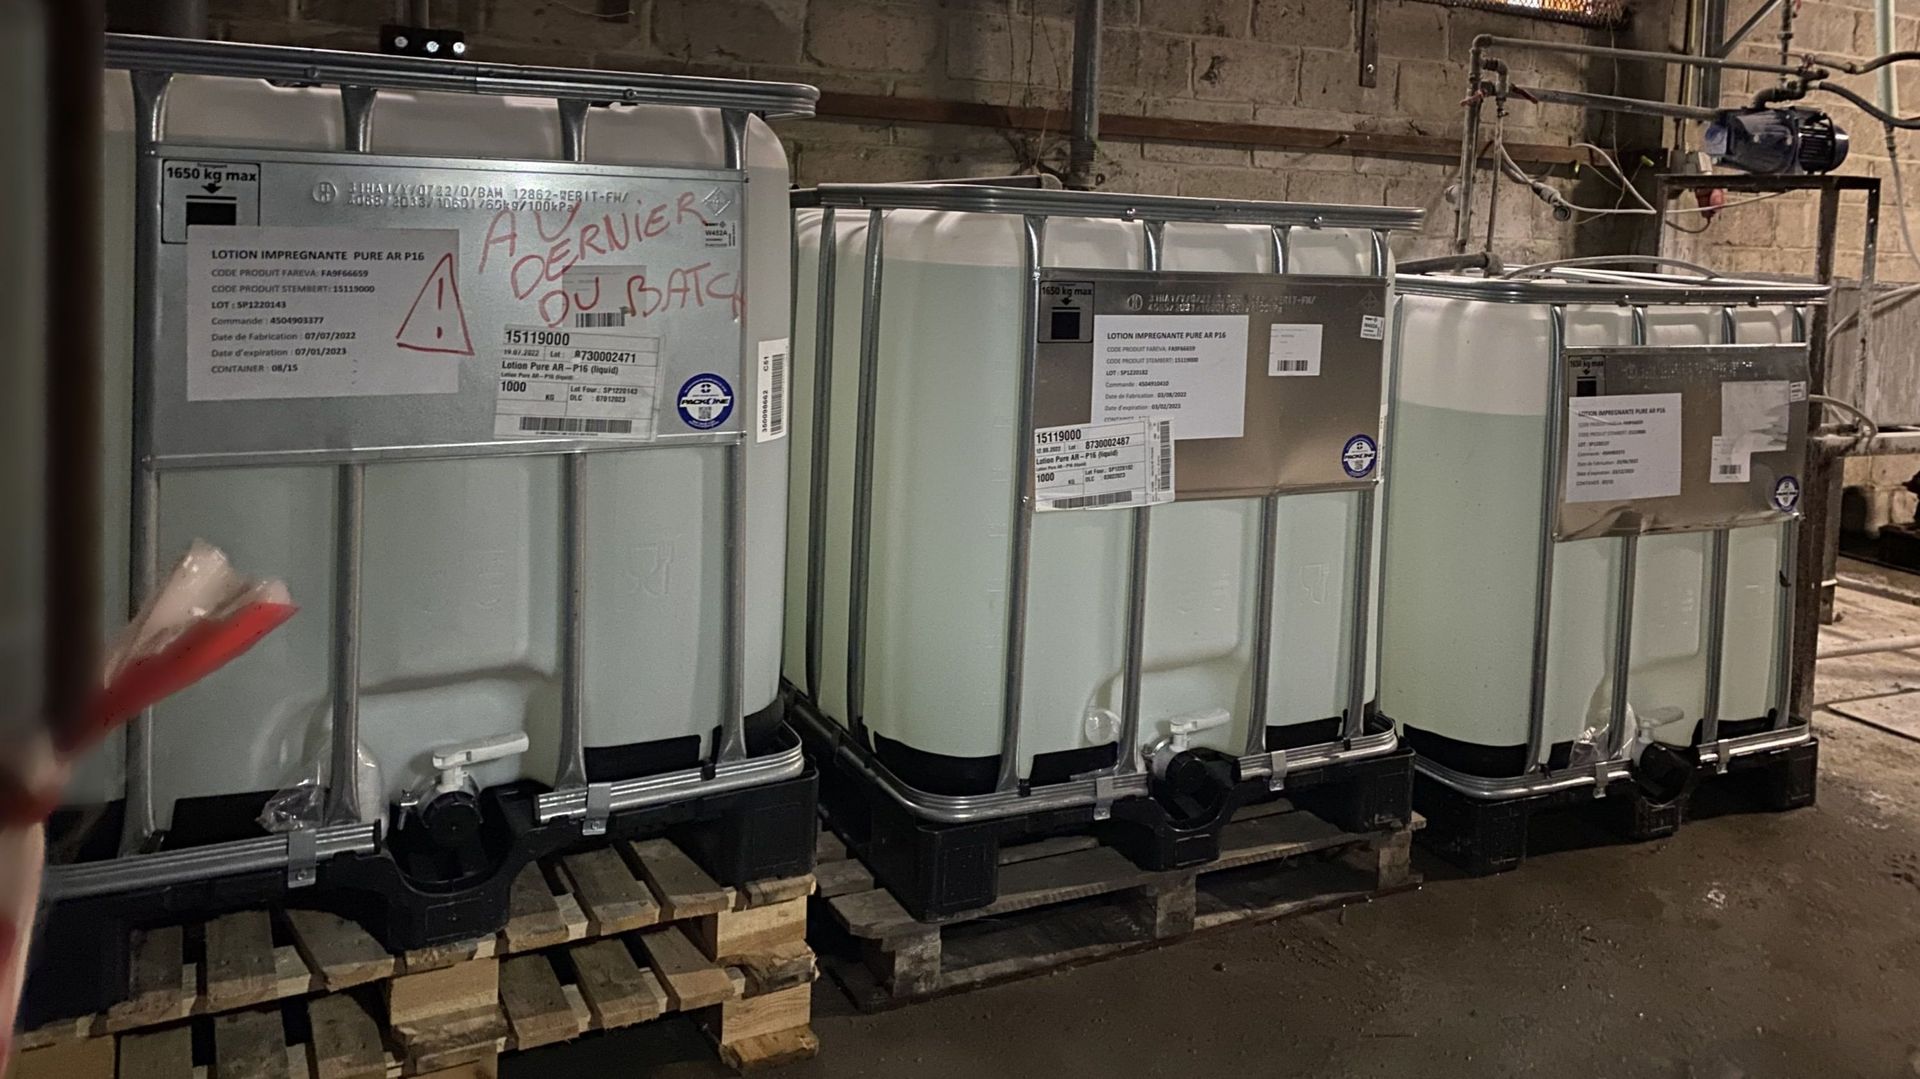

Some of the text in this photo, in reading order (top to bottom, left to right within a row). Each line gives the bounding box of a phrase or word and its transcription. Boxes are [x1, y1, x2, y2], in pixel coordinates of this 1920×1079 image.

[166, 166, 256, 183] 1650 kg max
[211, 250, 425, 261] LOTION IMPREGNANTE PURE AR P16
[211, 268, 237, 277] CODE
[240, 268, 280, 277] PRODUIT
[211, 284, 237, 293] CODE
[240, 284, 280, 293] PRODUIT
[1062, 286, 1072, 298] kg
[211, 332, 356, 341] Date de Fabrication 07/07/2022
[505, 330, 570, 346] 15119000
[1107, 332, 1134, 340] LOTION
[1135, 332, 1184, 340] IMPREGNANTE
[211, 349, 233, 358] Date
[294, 347, 346, 356] 07/01/2023
[502, 360, 528, 370] Lotion
[530, 362, 550, 372] Pure
[552, 363, 564, 372] AR
[572, 364, 588, 374] P16
[590, 364, 619, 376] (liquid)
[500, 380, 527, 392] 1000
[1036, 428, 1082, 444] 15119000
[1085, 436, 1130, 450] 8730002487
[1036, 472, 1054, 483] 1000
